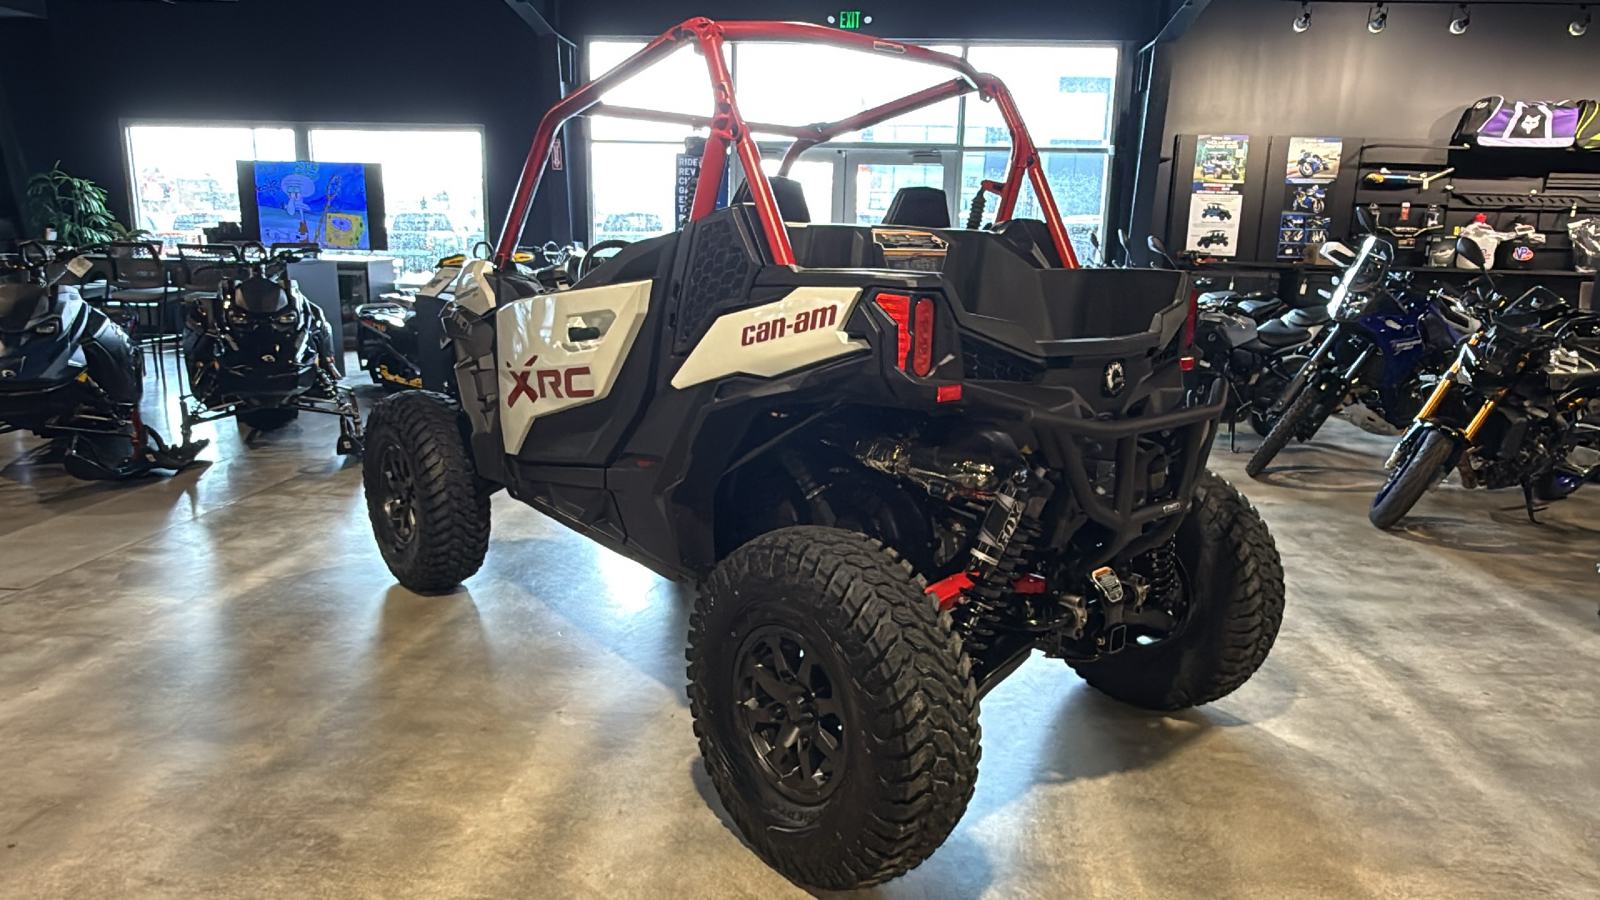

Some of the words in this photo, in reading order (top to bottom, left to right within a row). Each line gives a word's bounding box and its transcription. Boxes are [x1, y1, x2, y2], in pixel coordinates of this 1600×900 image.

[840, 11, 860, 28] EXIT
[678, 158, 698, 166] RIDE
[678, 168, 696, 176] REV
[1514, 246, 1529, 260] VP
[741, 304, 837, 347] can-am
[507, 354, 595, 408] XRC
